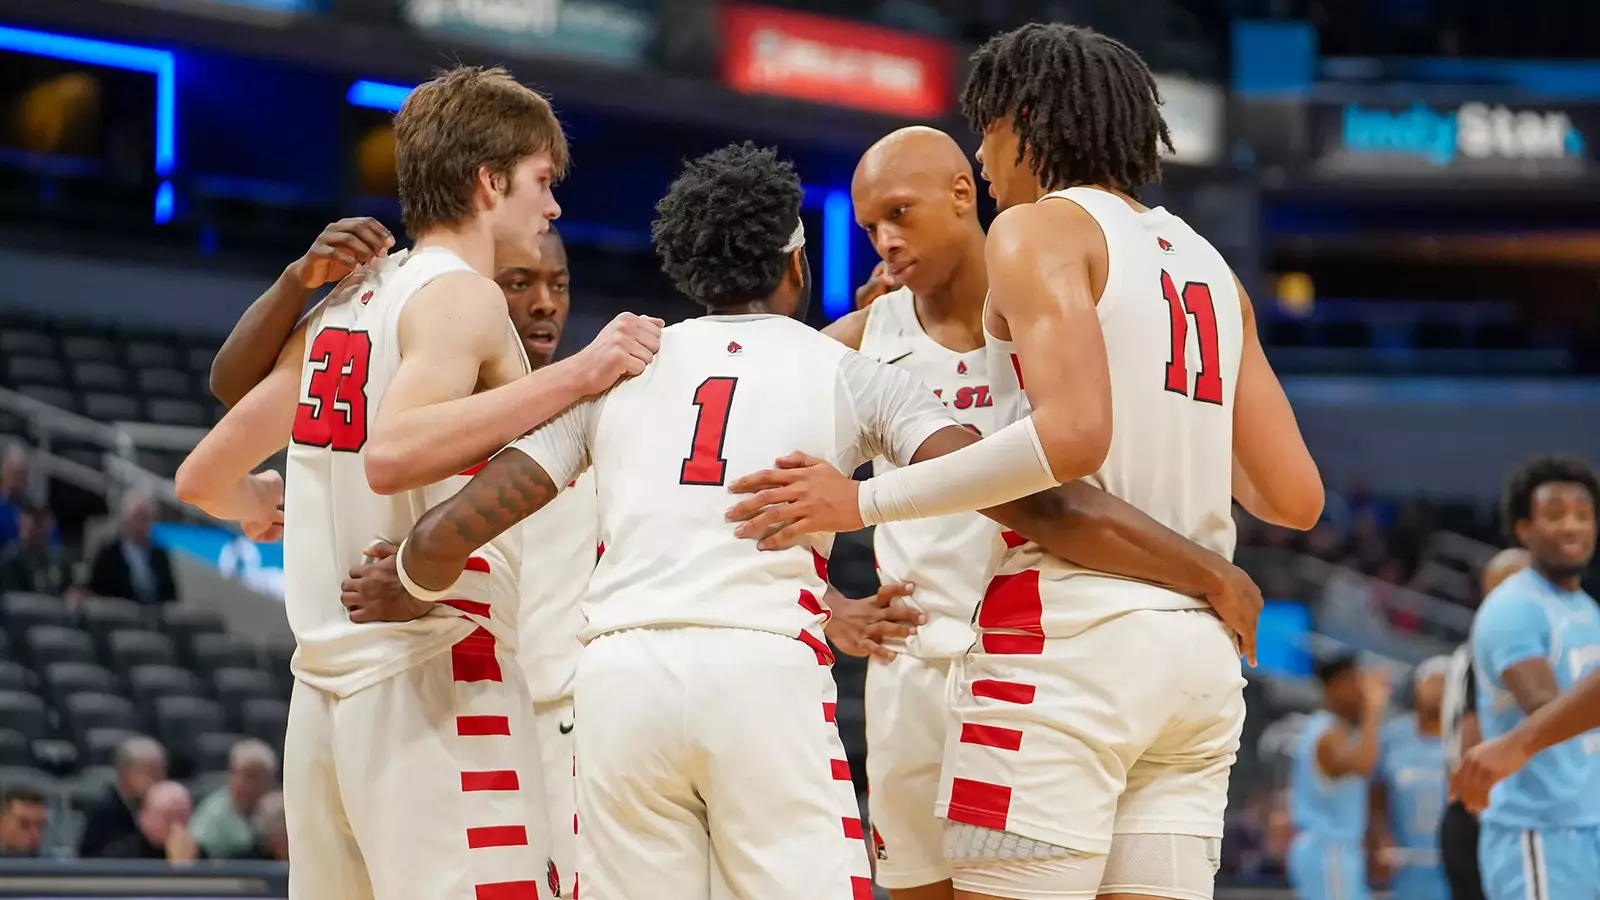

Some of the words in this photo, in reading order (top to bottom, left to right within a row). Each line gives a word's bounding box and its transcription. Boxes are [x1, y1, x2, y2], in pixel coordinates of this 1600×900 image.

[1342, 101, 1570, 166] IndyStar
[292, 326, 372, 453] 33
[1160, 268, 1223, 406] 11
[679, 376, 738, 486] 1
